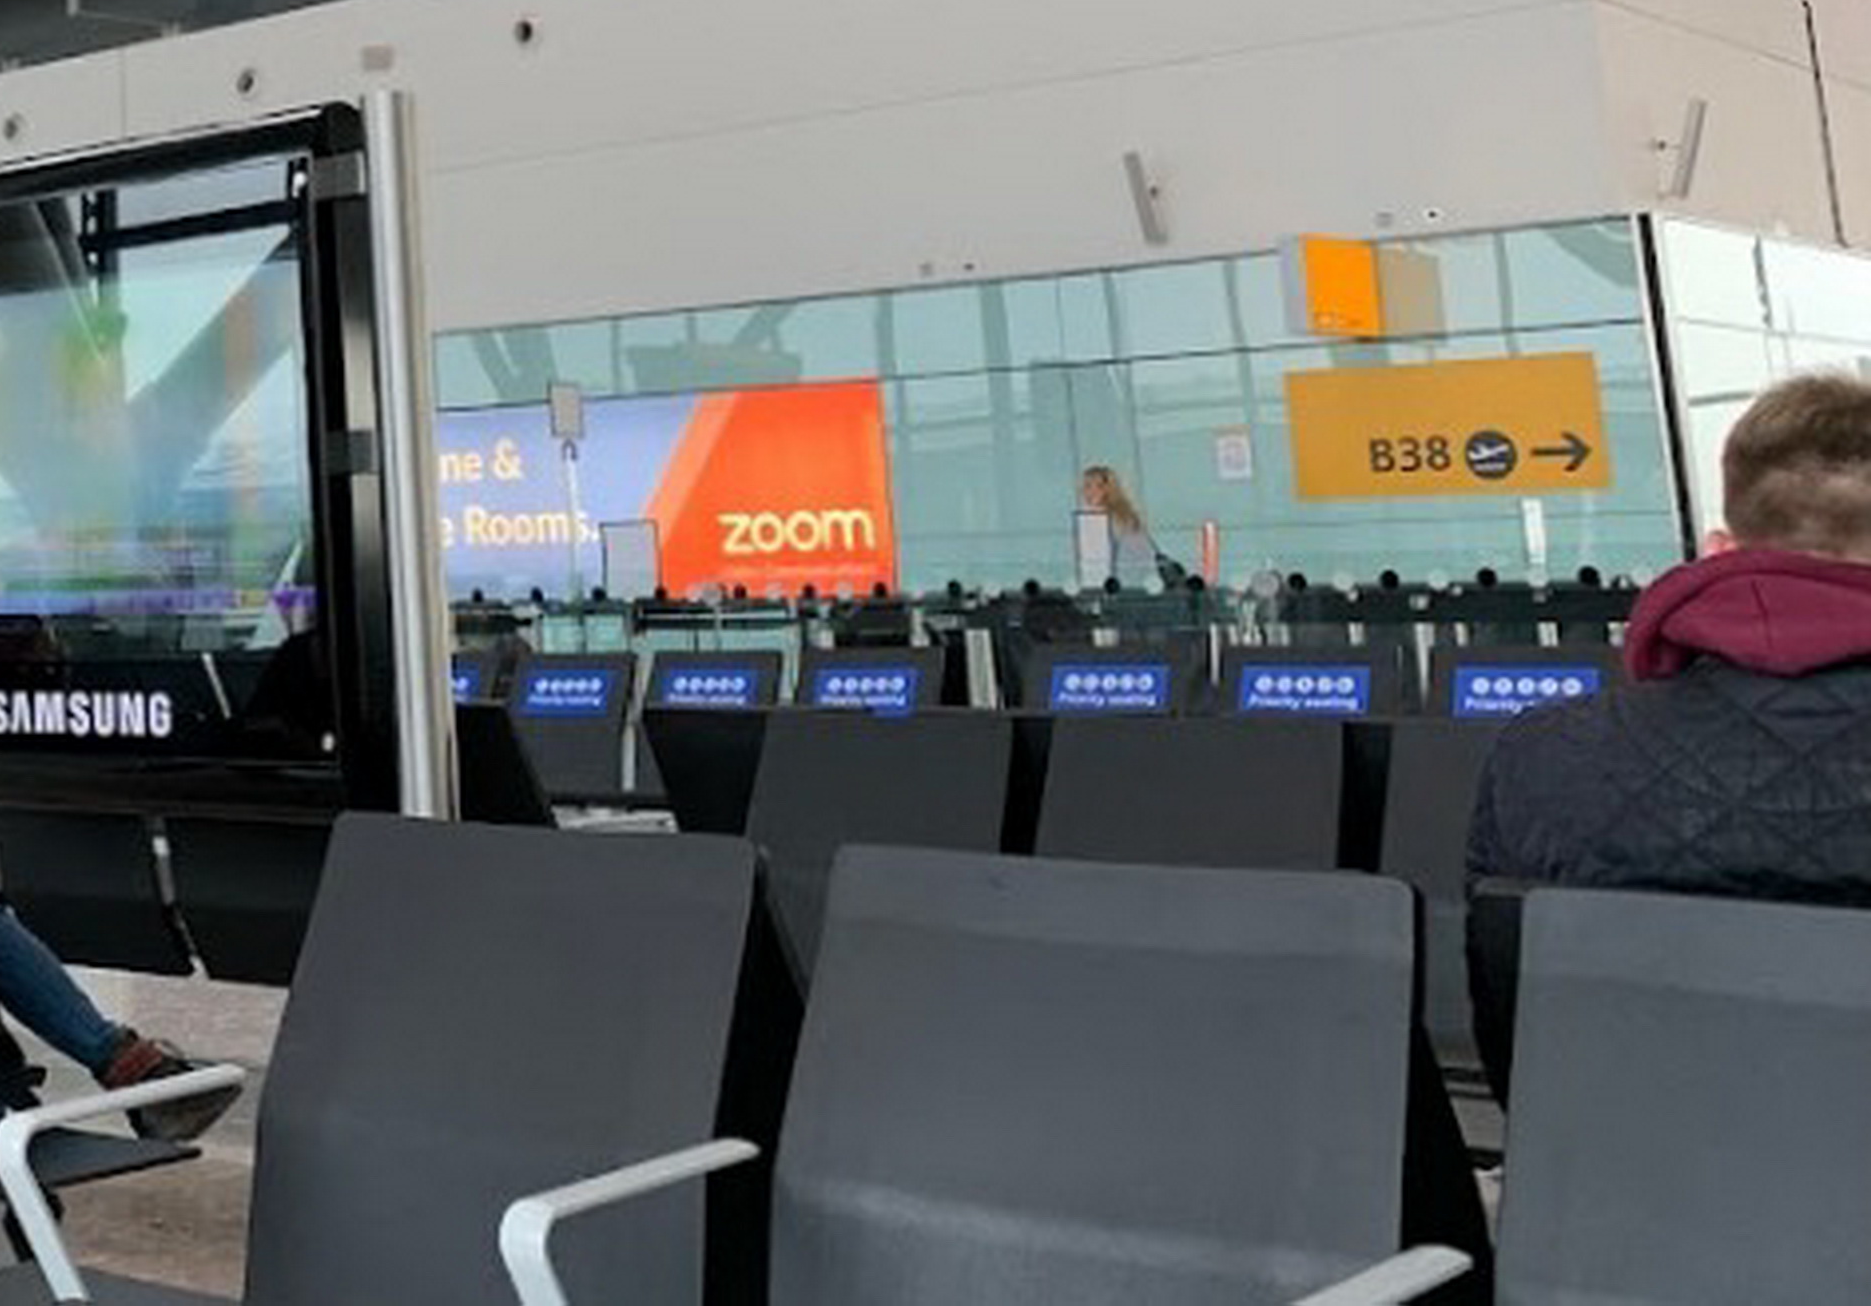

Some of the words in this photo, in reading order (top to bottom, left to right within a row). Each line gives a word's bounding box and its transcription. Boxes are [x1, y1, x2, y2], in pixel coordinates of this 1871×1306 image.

[493, 435, 524, 481] &
[1369, 434, 1452, 474] B38
[717, 508, 876, 554] zoom
